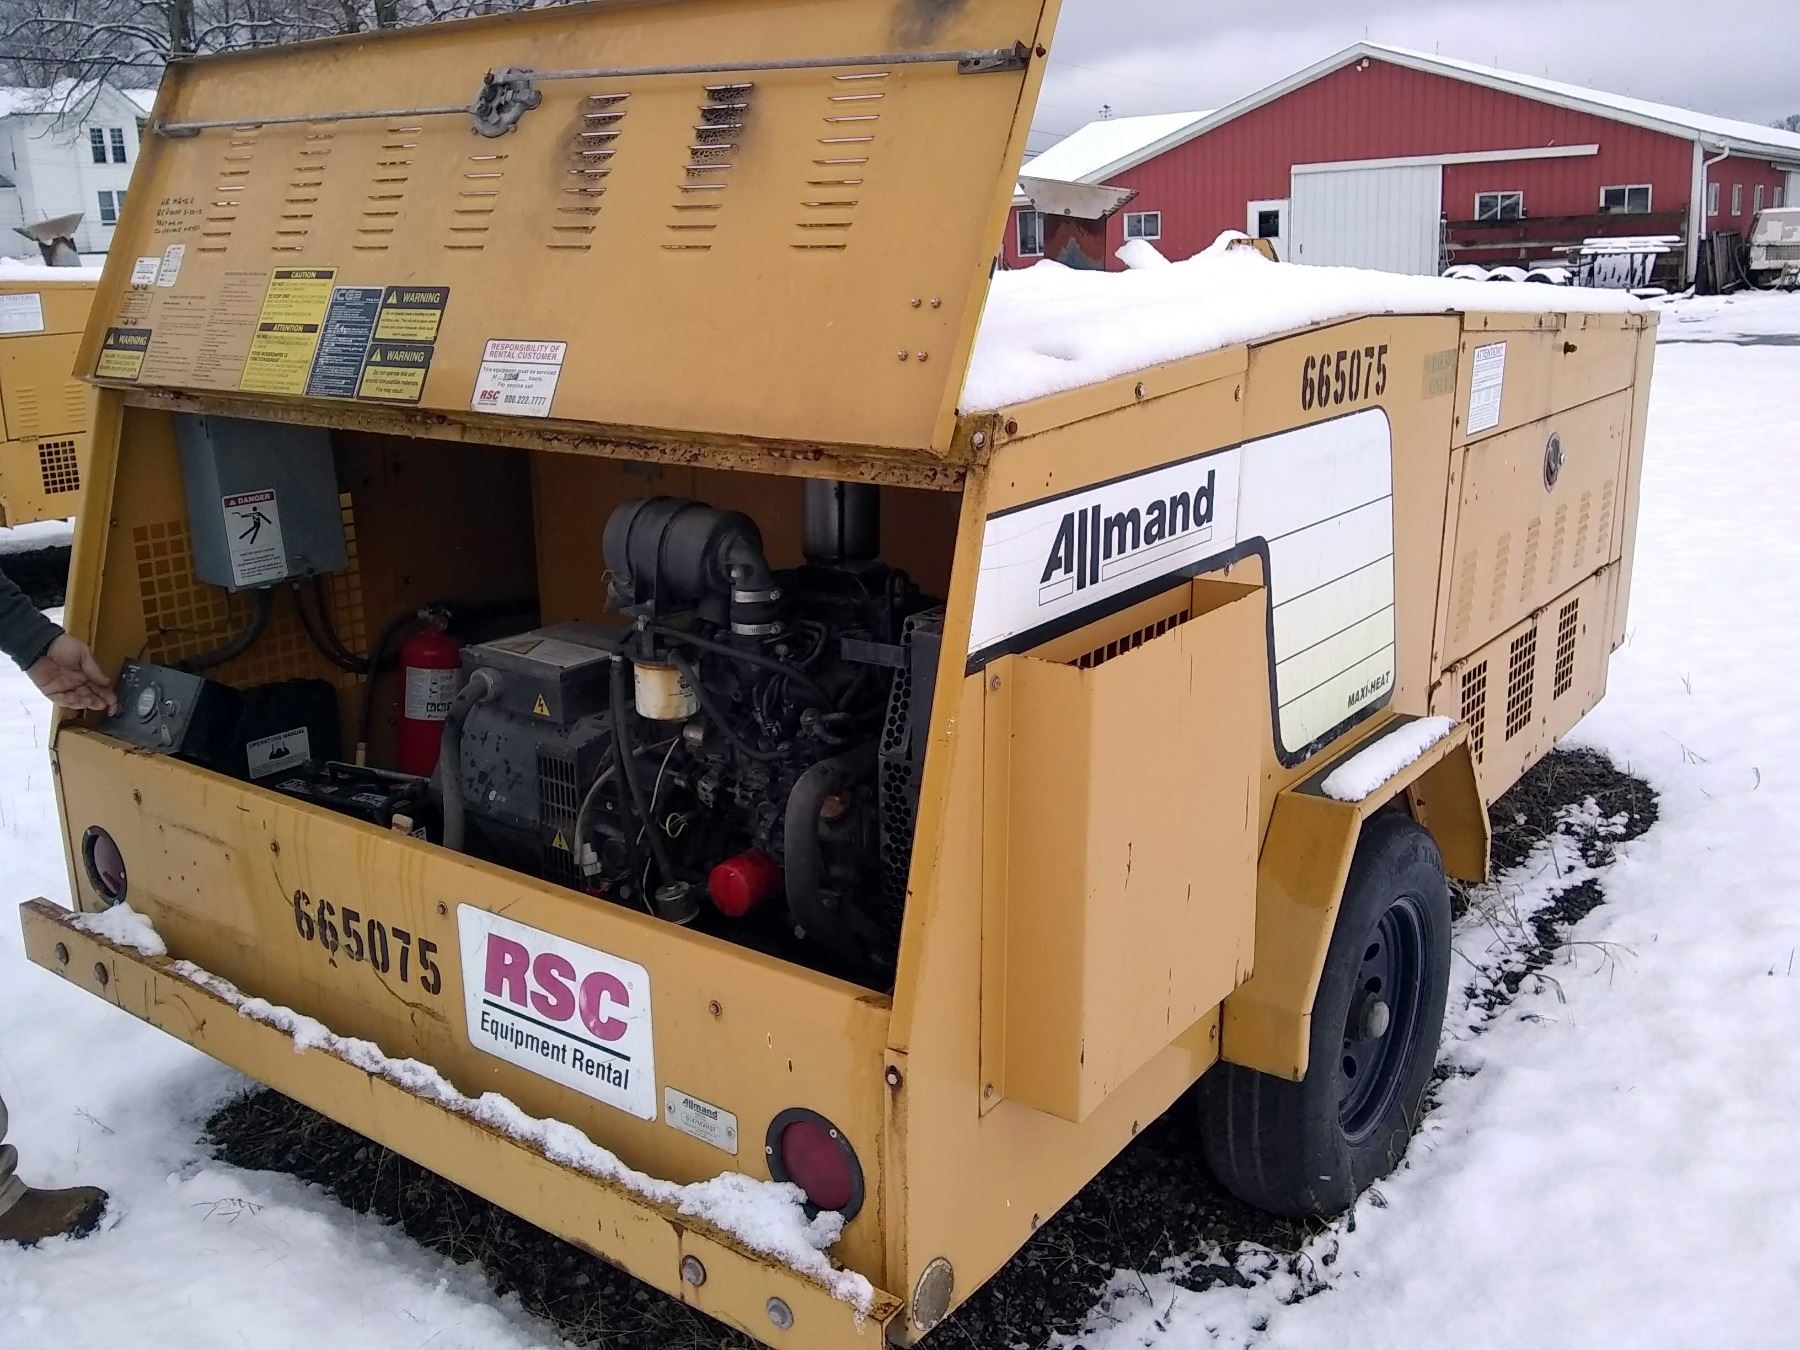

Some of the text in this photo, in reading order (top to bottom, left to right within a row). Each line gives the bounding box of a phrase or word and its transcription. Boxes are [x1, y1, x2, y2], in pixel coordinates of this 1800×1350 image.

[402, 292, 440, 304] WARNING
[118, 334, 147, 346] WARNING
[491, 342, 548, 352] RESPONSIBILITY
[386, 350, 424, 362] WARNING
[489, 350, 557, 360] RENTAL CUSTOMER
[1302, 344, 1388, 412] 665075
[480, 390, 547, 406] RSC 800.222.7777
[238, 493, 270, 504] DANGER
[1040, 468, 1216, 591] Allmand
[1348, 670, 1390, 708] MAXI-HEAT
[294, 890, 442, 995] 665075
[484, 932, 630, 1042] RSC
[480, 1010, 630, 1090] Equipment Rental
[682, 1098, 718, 1118] Allmand
